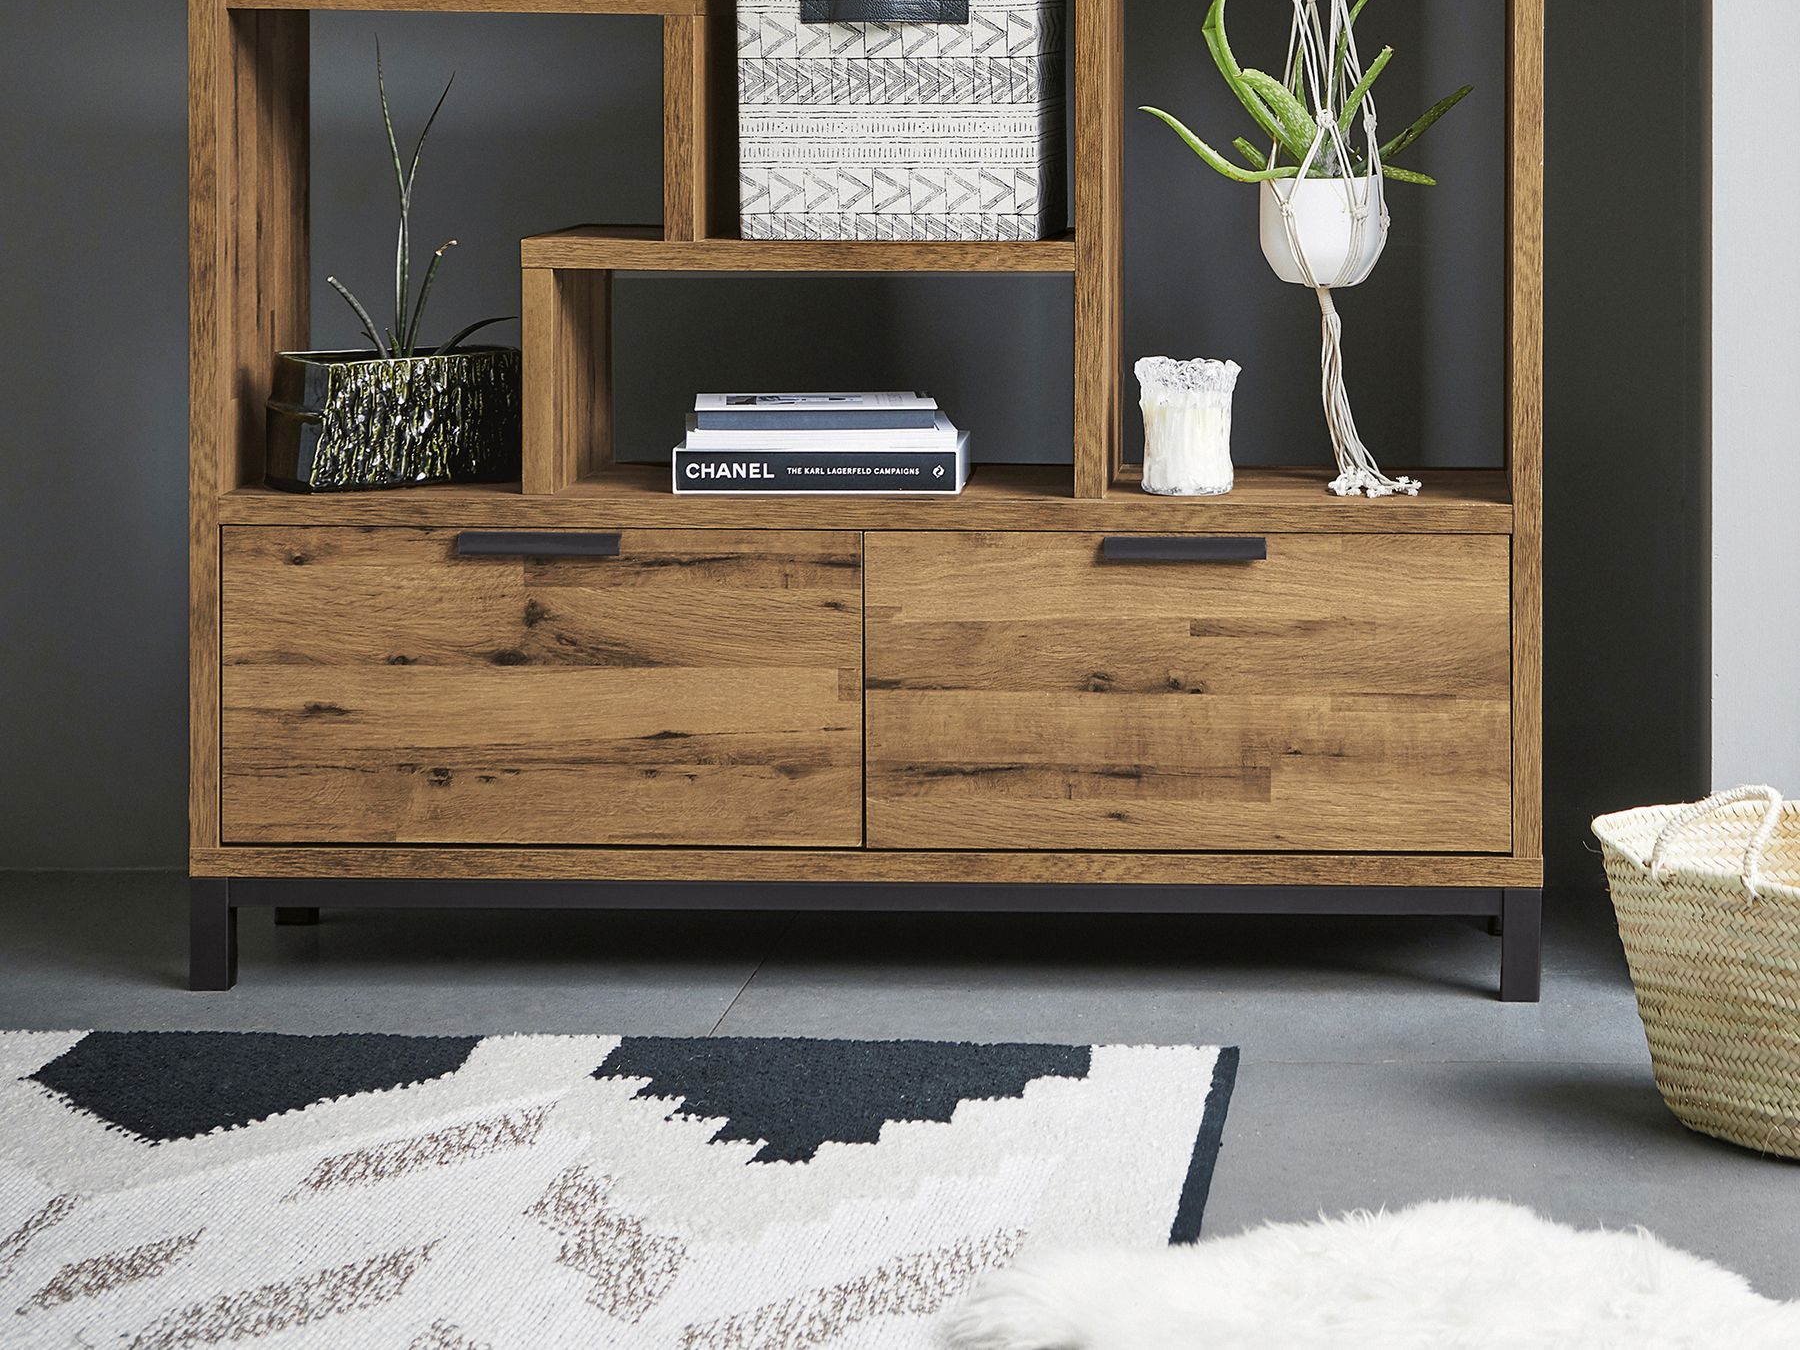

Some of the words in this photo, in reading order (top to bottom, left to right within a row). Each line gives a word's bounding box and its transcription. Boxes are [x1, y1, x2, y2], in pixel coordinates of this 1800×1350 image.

[685, 462, 775, 479] CHANEL
[787, 467, 802, 475] THE
[804, 467, 825, 475] KARL
[827, 467, 872, 475] LAGERFELD
[874, 467, 920, 475] CAMPAIGNS
